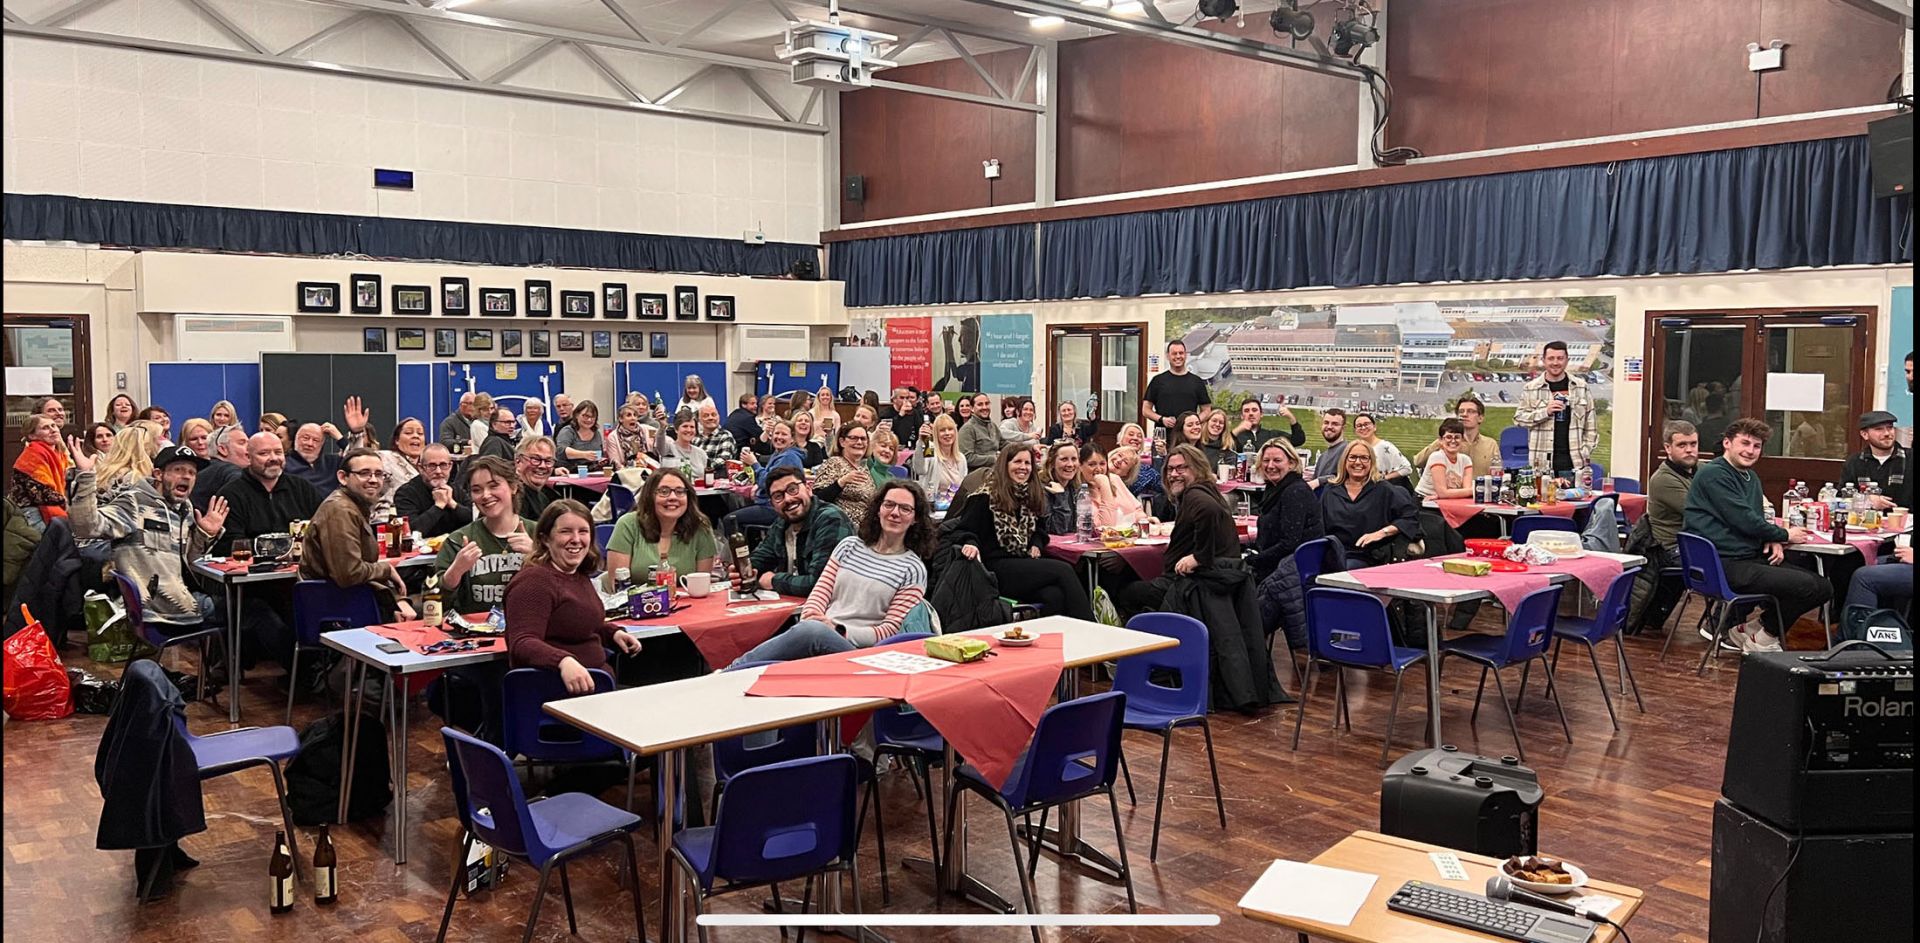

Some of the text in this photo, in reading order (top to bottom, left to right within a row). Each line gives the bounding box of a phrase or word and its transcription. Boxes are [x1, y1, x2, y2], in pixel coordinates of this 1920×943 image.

[472, 584, 506, 603] SUS
[1869, 629, 1898, 640] VANS
[1844, 696, 1913, 717] Rolan
